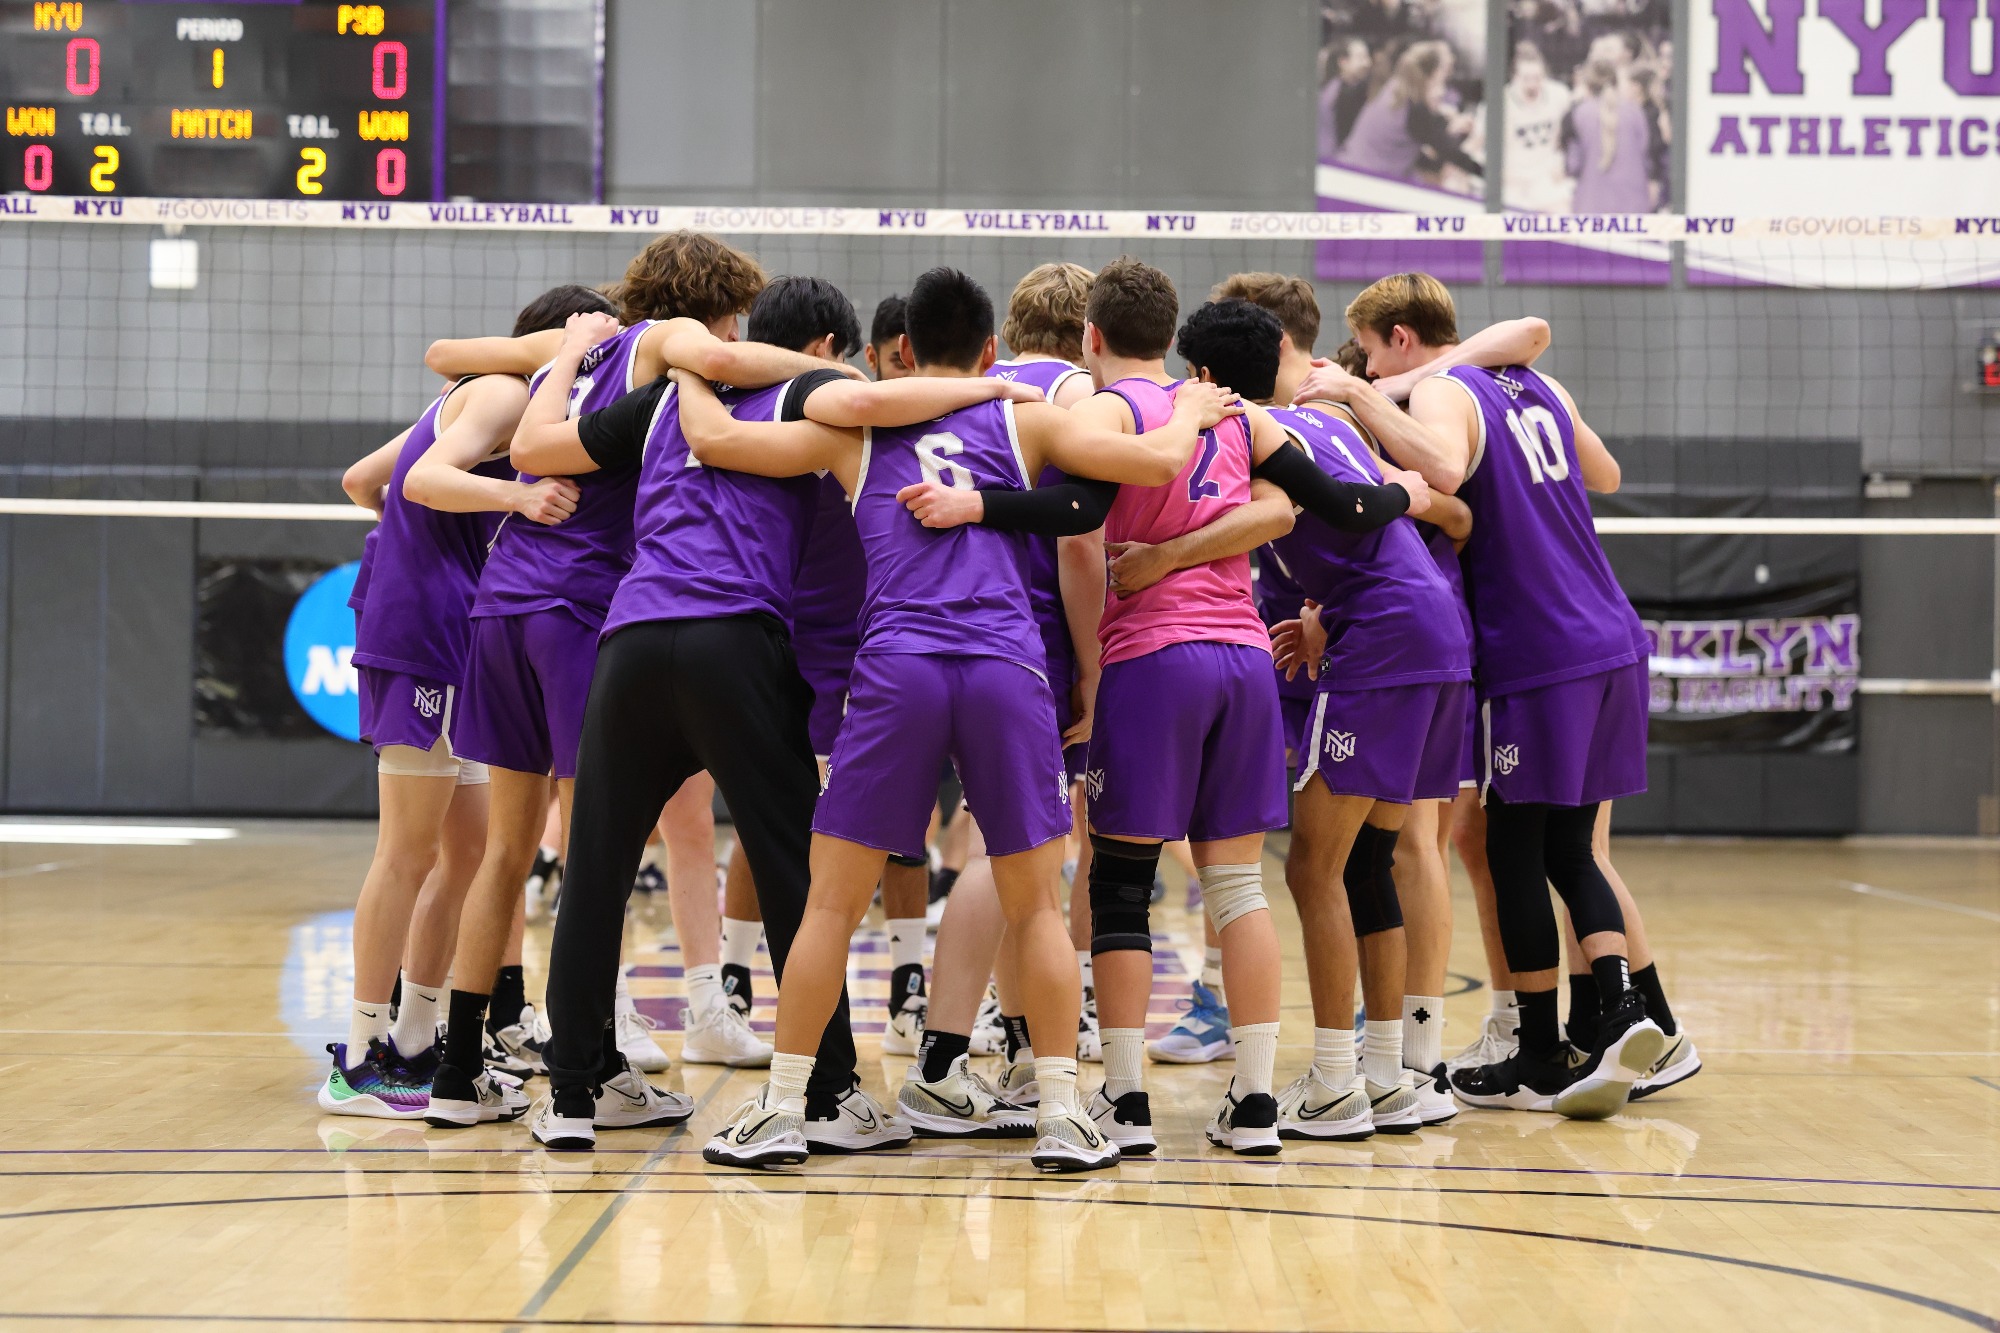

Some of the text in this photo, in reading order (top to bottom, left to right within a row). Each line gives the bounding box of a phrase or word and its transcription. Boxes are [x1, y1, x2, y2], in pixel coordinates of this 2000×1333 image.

[34, 2, 82, 31] NYU
[177, 17, 244, 41] PERIOD
[338, 5, 384, 35] PSB
[66, 38, 100, 95] 0
[212, 48, 224, 88] 1
[372, 42, 407, 99] 0
[7, 107, 56, 137] WON
[171, 109, 252, 139] MATCH
[359, 111, 409, 141] WON
[25, 145, 52, 190] 0
[90, 146, 119, 192] 2
[297, 147, 327, 194] 2
[376, 148, 406, 195] 0
[74, 200, 123, 216] NYU
[158, 200, 308, 220] #GOVIOLETS
[342, 205, 390, 221] NYU
[429, 206, 573, 224] VOLLEYBALL
[610, 209, 659, 224] NYU
[694, 208, 845, 227] #GOVIOLETS
[878, 211, 926, 227] NYU
[965, 213, 1110, 230] VOLLEYBALL
[1146, 215, 1196, 231] NYU
[1230, 215, 1382, 233] #GOVIOLETS
[1415, 216, 1465, 232] NYU
[1503, 216, 1648, 233] VOLLEYBALL
[1685, 218, 1734, 234] NYU
[1769, 216, 1921, 235] #GOVIOLETS
[915, 432, 975, 491] 6
[1506, 405, 1569, 484] 10
[1676, 674, 1858, 713] FACILITY
